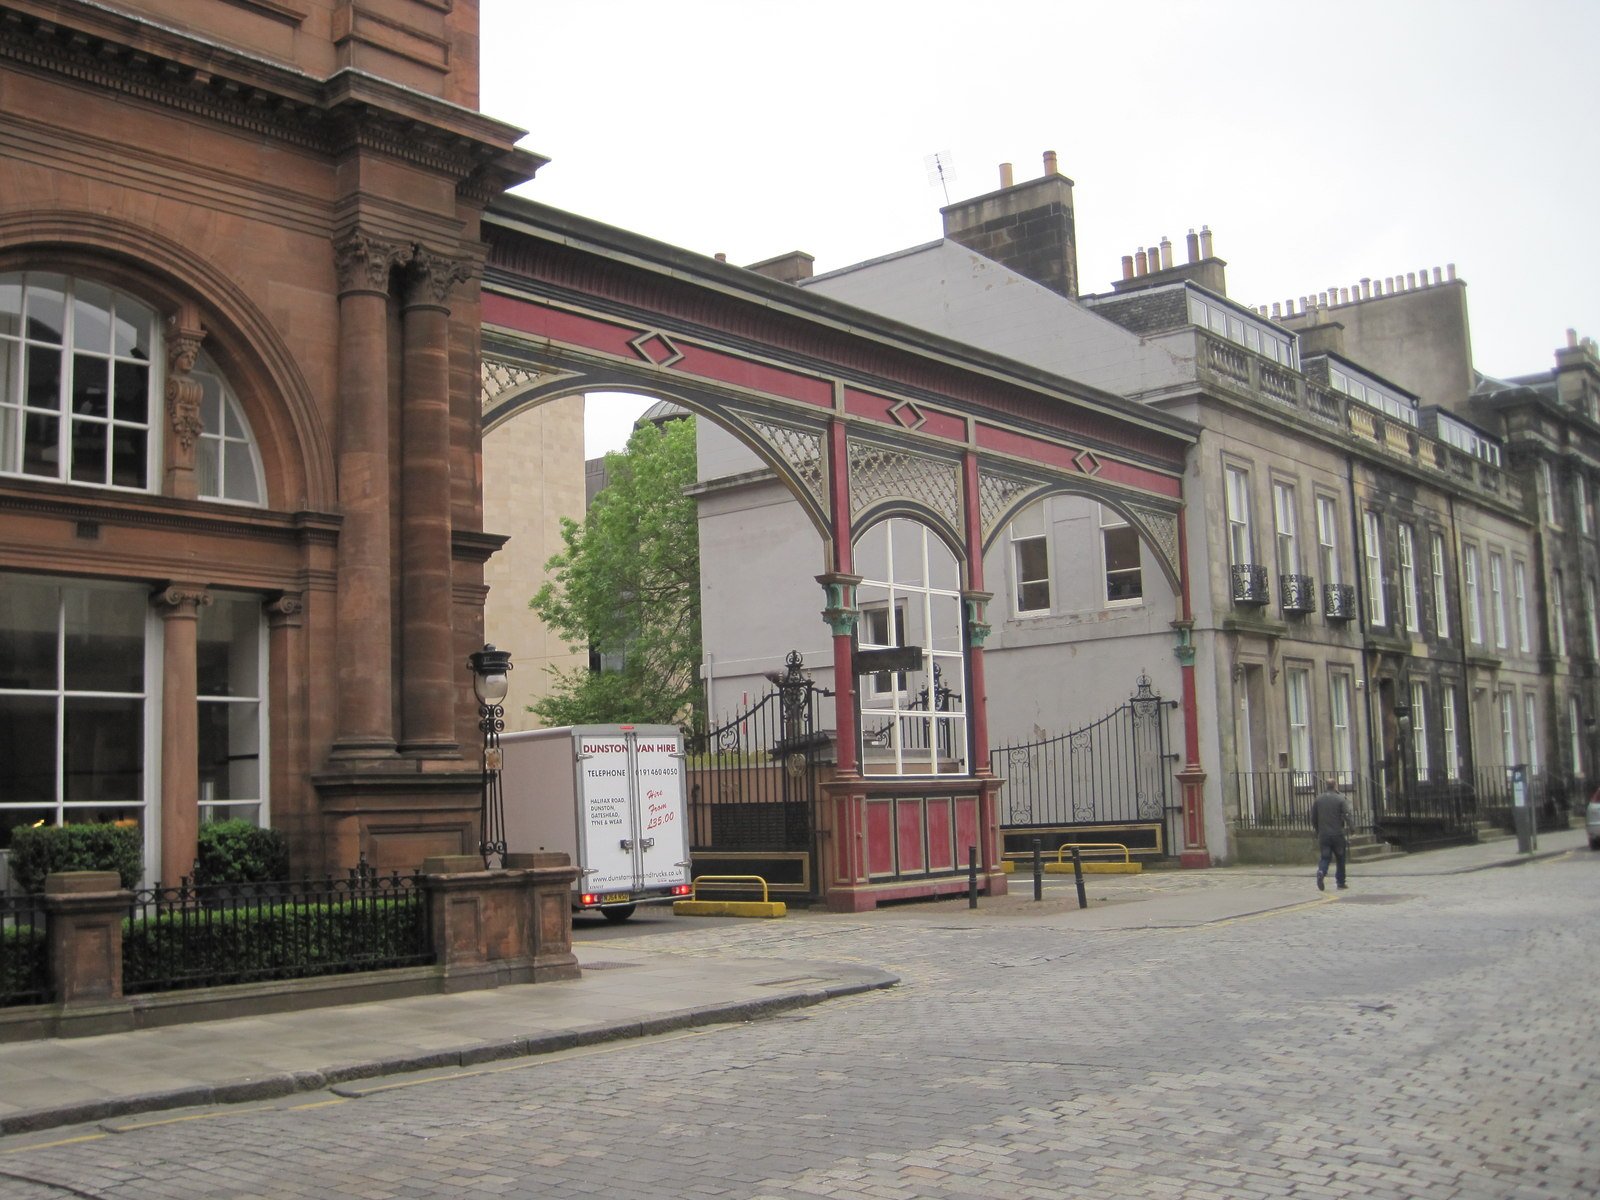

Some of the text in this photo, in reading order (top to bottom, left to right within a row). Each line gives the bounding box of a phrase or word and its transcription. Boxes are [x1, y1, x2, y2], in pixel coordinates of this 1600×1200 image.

[583, 744, 676, 753] DUNSTON VAN HIRE
[588, 769, 625, 777] TELEPHONE
[646, 790, 663, 800] Hire
[648, 803, 667, 815] From
